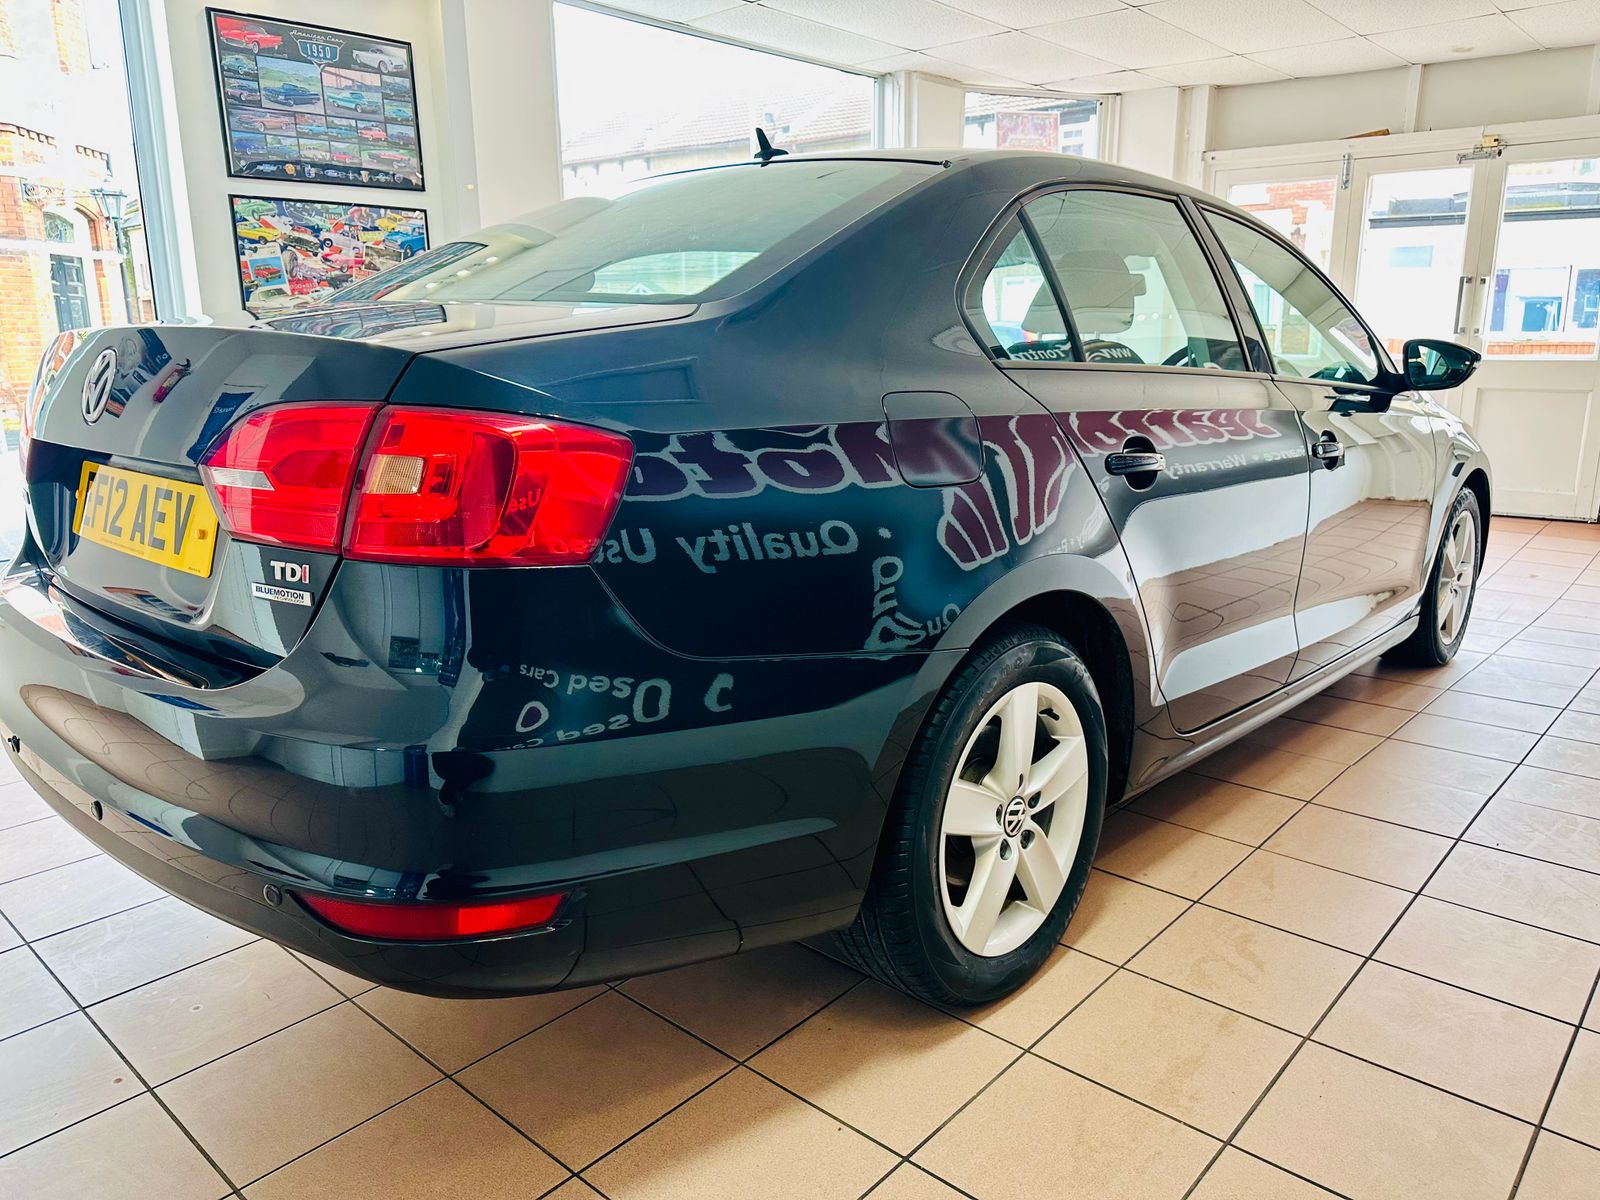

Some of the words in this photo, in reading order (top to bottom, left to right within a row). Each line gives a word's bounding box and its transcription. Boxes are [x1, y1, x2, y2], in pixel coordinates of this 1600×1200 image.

[306, 43, 331, 59] 1950
[129, 484, 195, 556] AEV
[270, 560, 310, 584] TDI
[255, 585, 305, 600] BLUEMOTION
